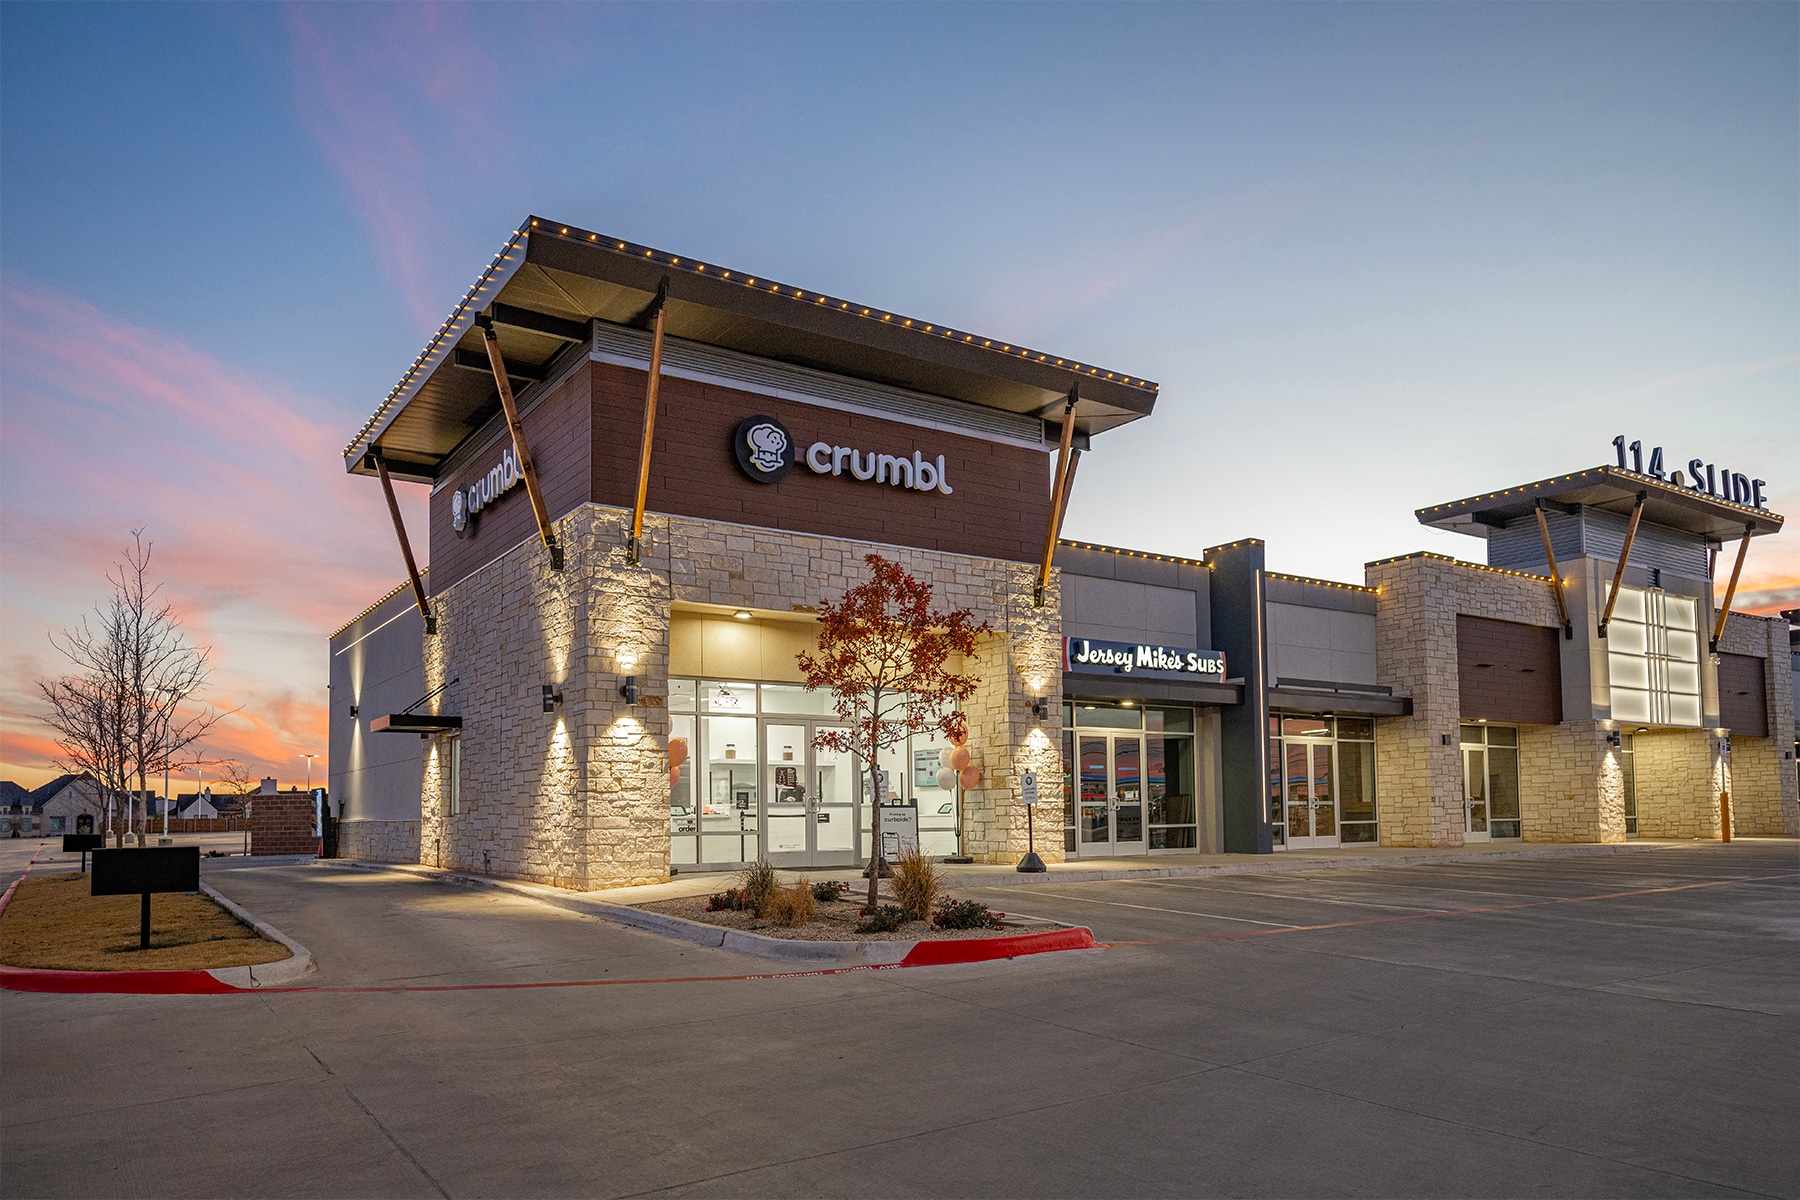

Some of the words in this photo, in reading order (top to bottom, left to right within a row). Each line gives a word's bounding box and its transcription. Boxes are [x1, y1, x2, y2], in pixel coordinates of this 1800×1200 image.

[468, 442, 523, 513] crumbl
[806, 441, 953, 494] crumbl
[1612, 435, 1666, 482] 114
[1688, 458, 1769, 512] SLIDE
[1077, 640, 1133, 673] Jersey
[1136, 645, 1184, 671] Mike's
[1187, 652, 1224, 674] SUBS
